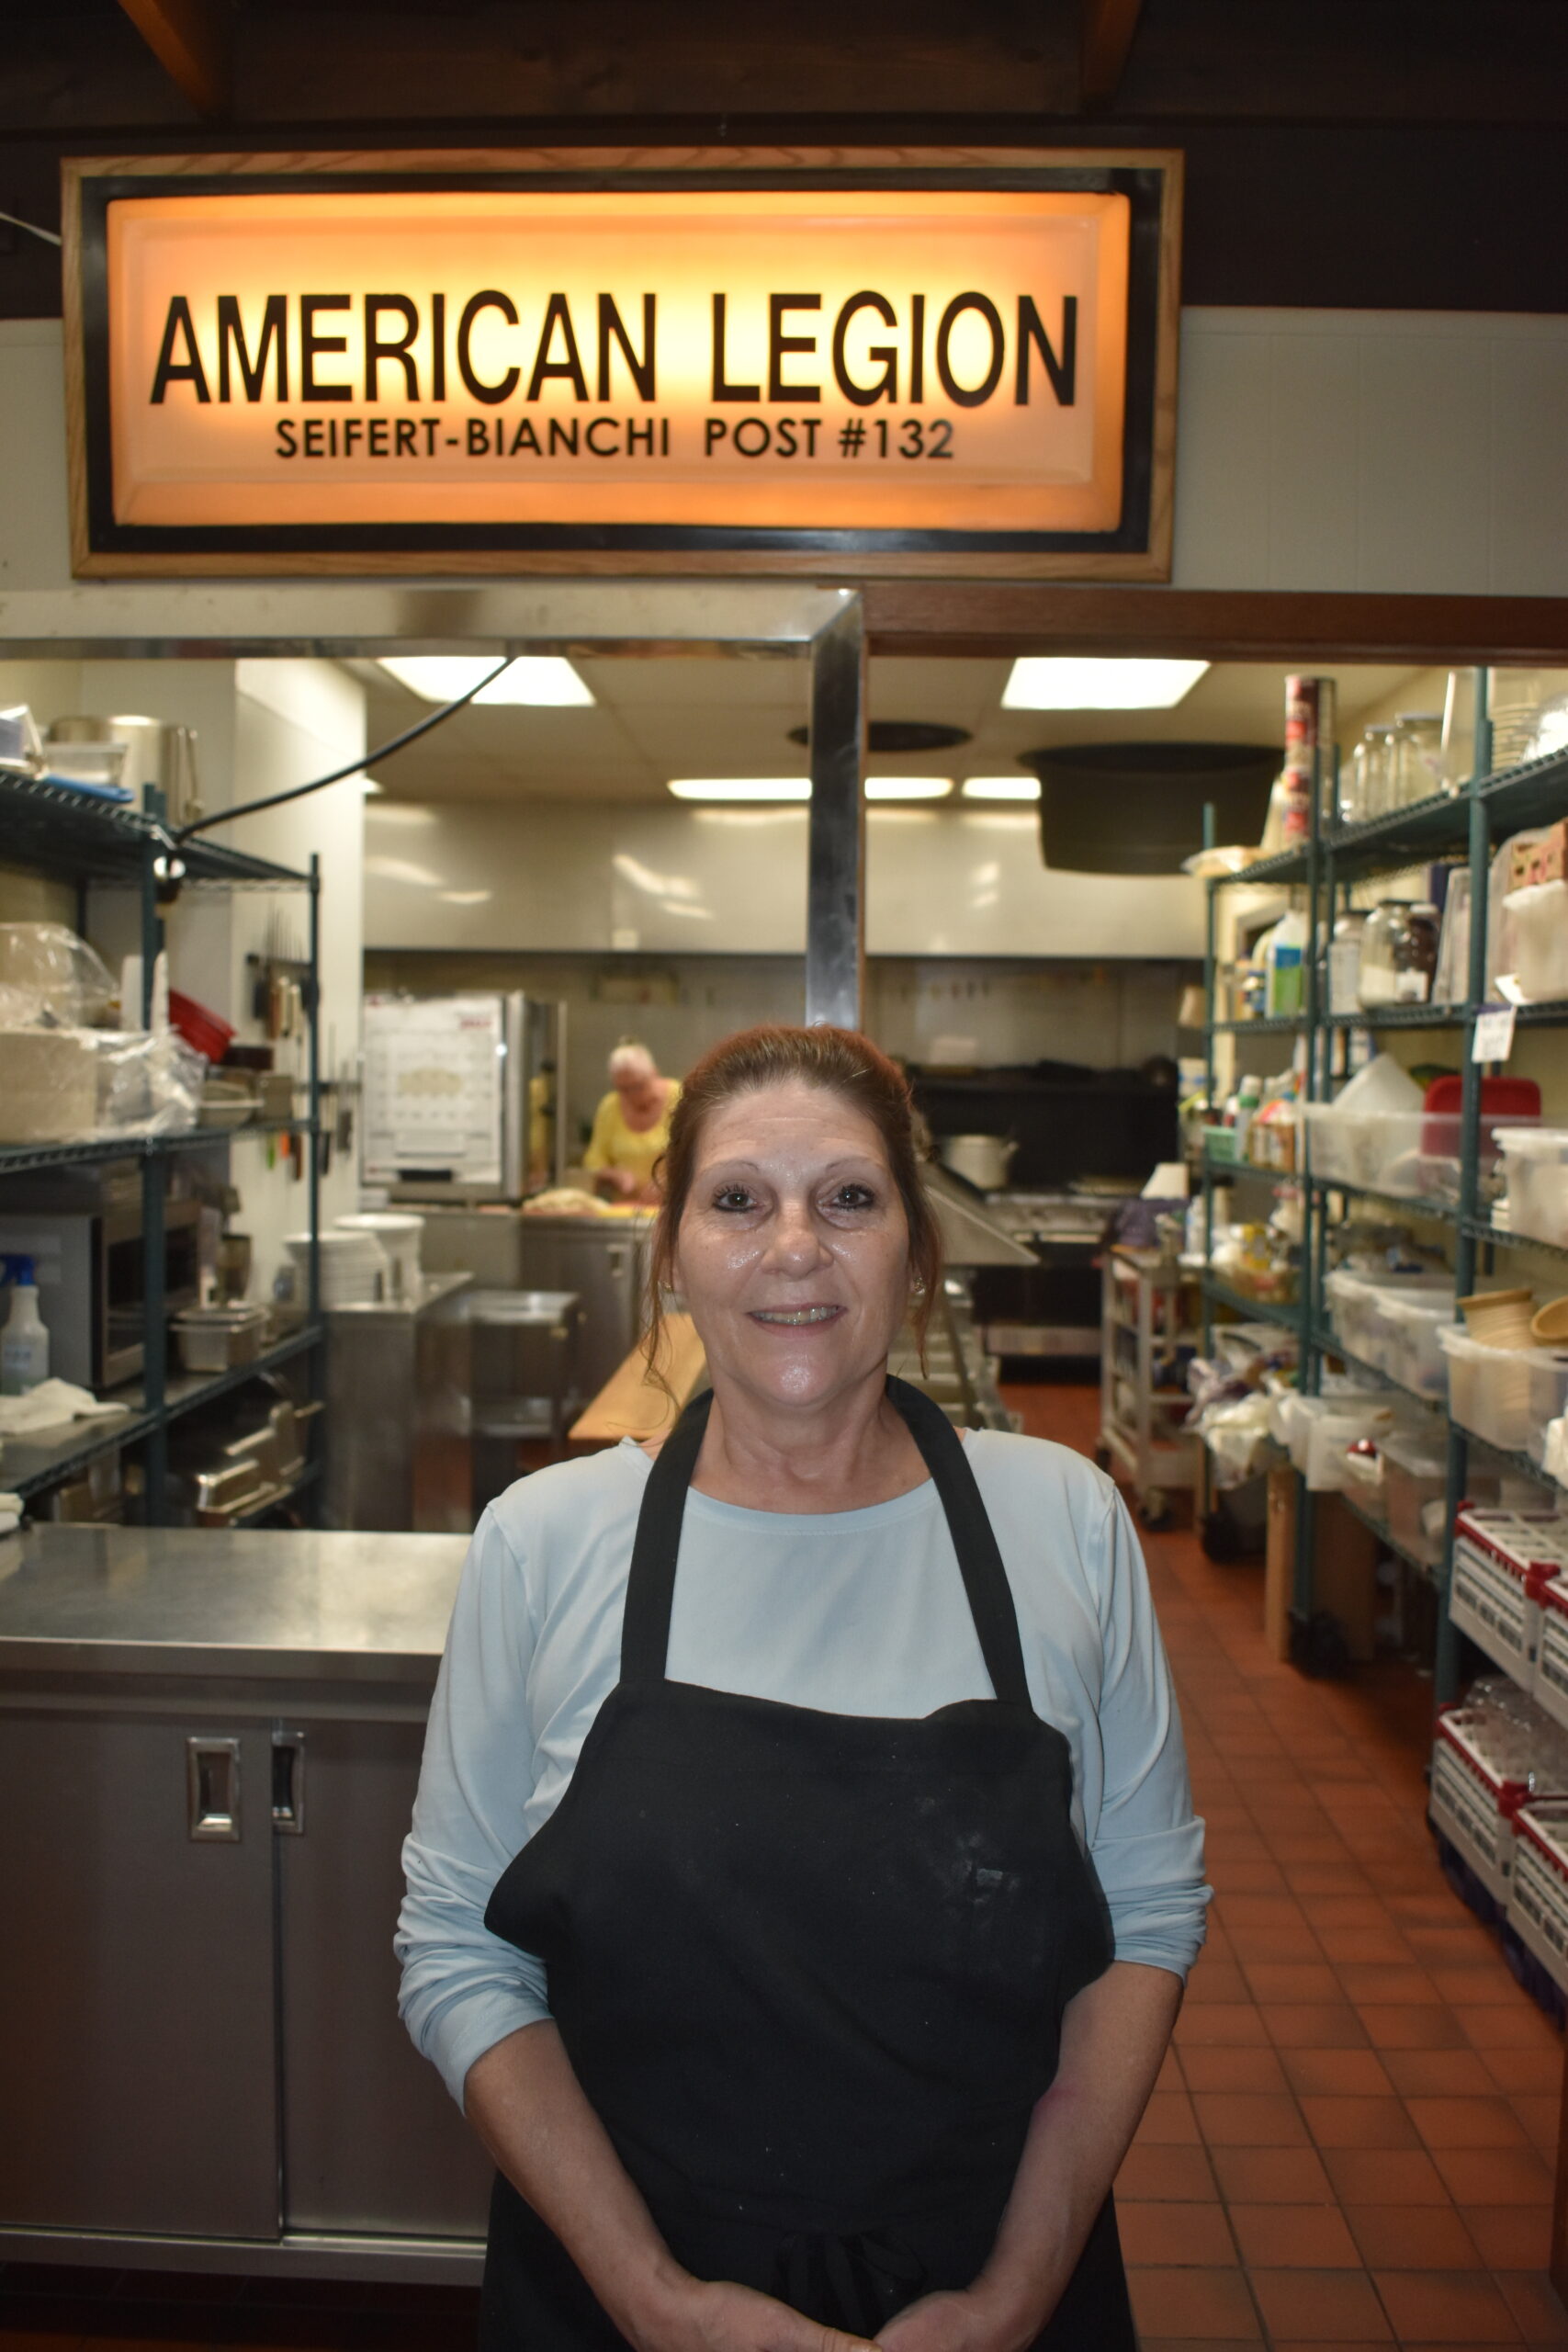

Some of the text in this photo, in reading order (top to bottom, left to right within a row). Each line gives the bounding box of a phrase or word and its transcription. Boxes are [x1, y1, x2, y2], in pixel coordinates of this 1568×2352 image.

[150, 289, 1077, 407] AMERICAN LEGION
[276, 417, 954, 459] SEIFERT-BIANCHI POST #132
